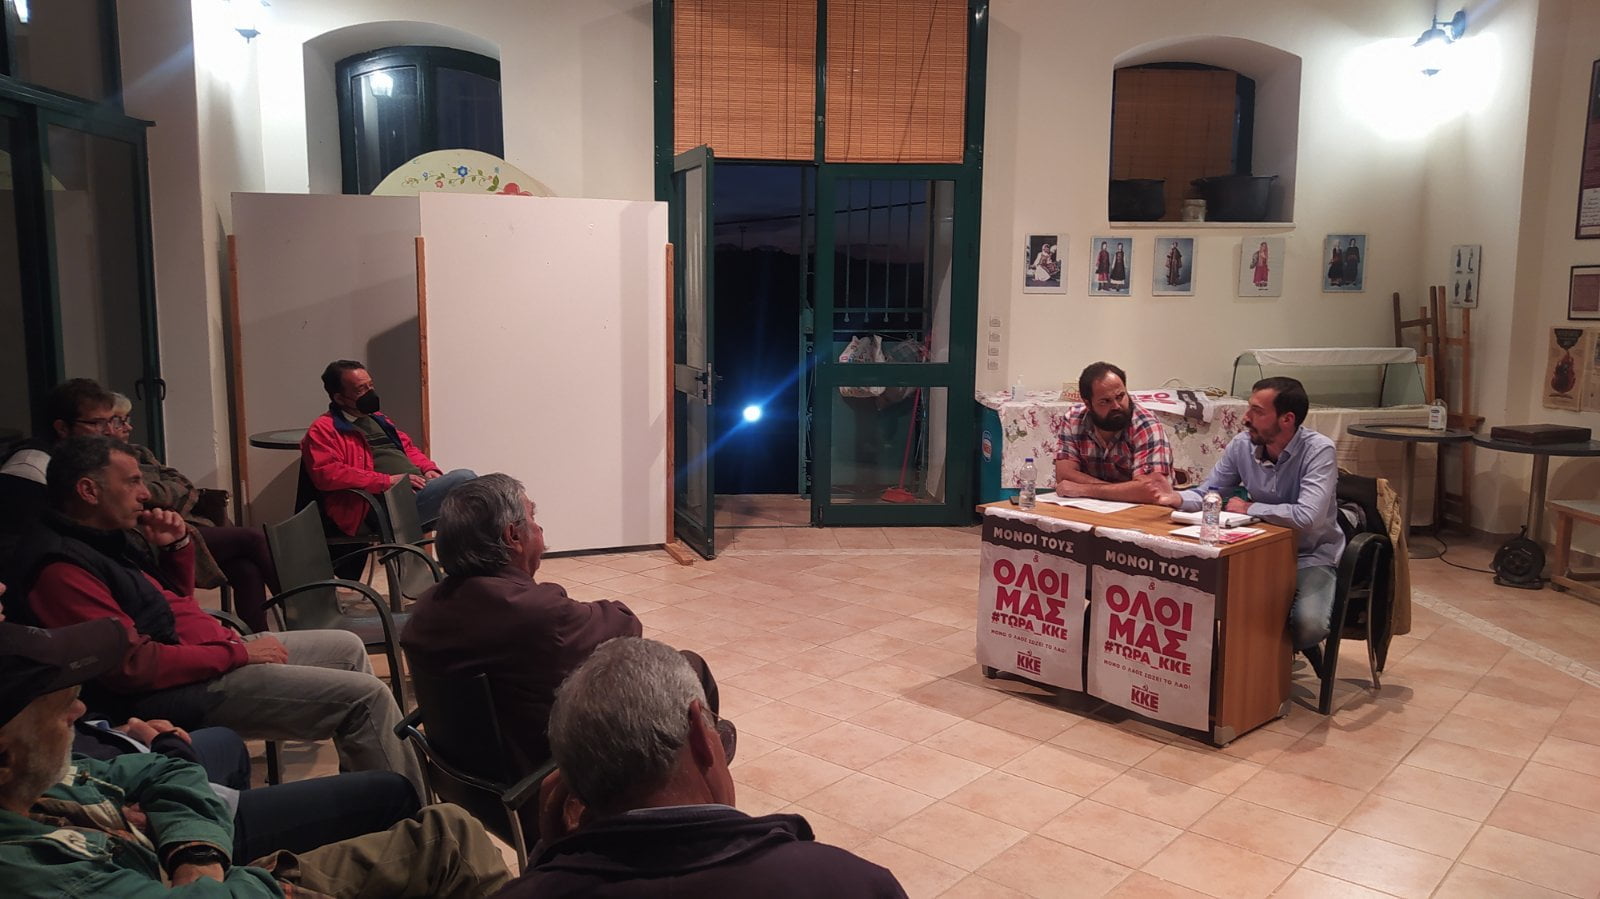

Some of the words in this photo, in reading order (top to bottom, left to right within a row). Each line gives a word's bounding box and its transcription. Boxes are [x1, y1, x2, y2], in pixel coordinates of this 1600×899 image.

[993, 527, 1037, 545] ΜΟΝΟΙ
[1041, 536, 1074, 553] ΤΟΥΣ
[993, 559, 1069, 599] ΟΛΟΙ
[1105, 550, 1153, 571] ΜΟΝΟΙ
[1159, 561, 1200, 581] ΤΟΥΣ
[1148, 582, 1155, 590] &
[996, 586, 1066, 627] ΜΑΣ
[1106, 585, 1192, 631] ΟΛΟΙ
[1109, 613, 1187, 660] ΜΑΣ
[1017, 654, 1041, 672] ΚΚΕ
[1131, 689, 1159, 709] ΚΚΕ
